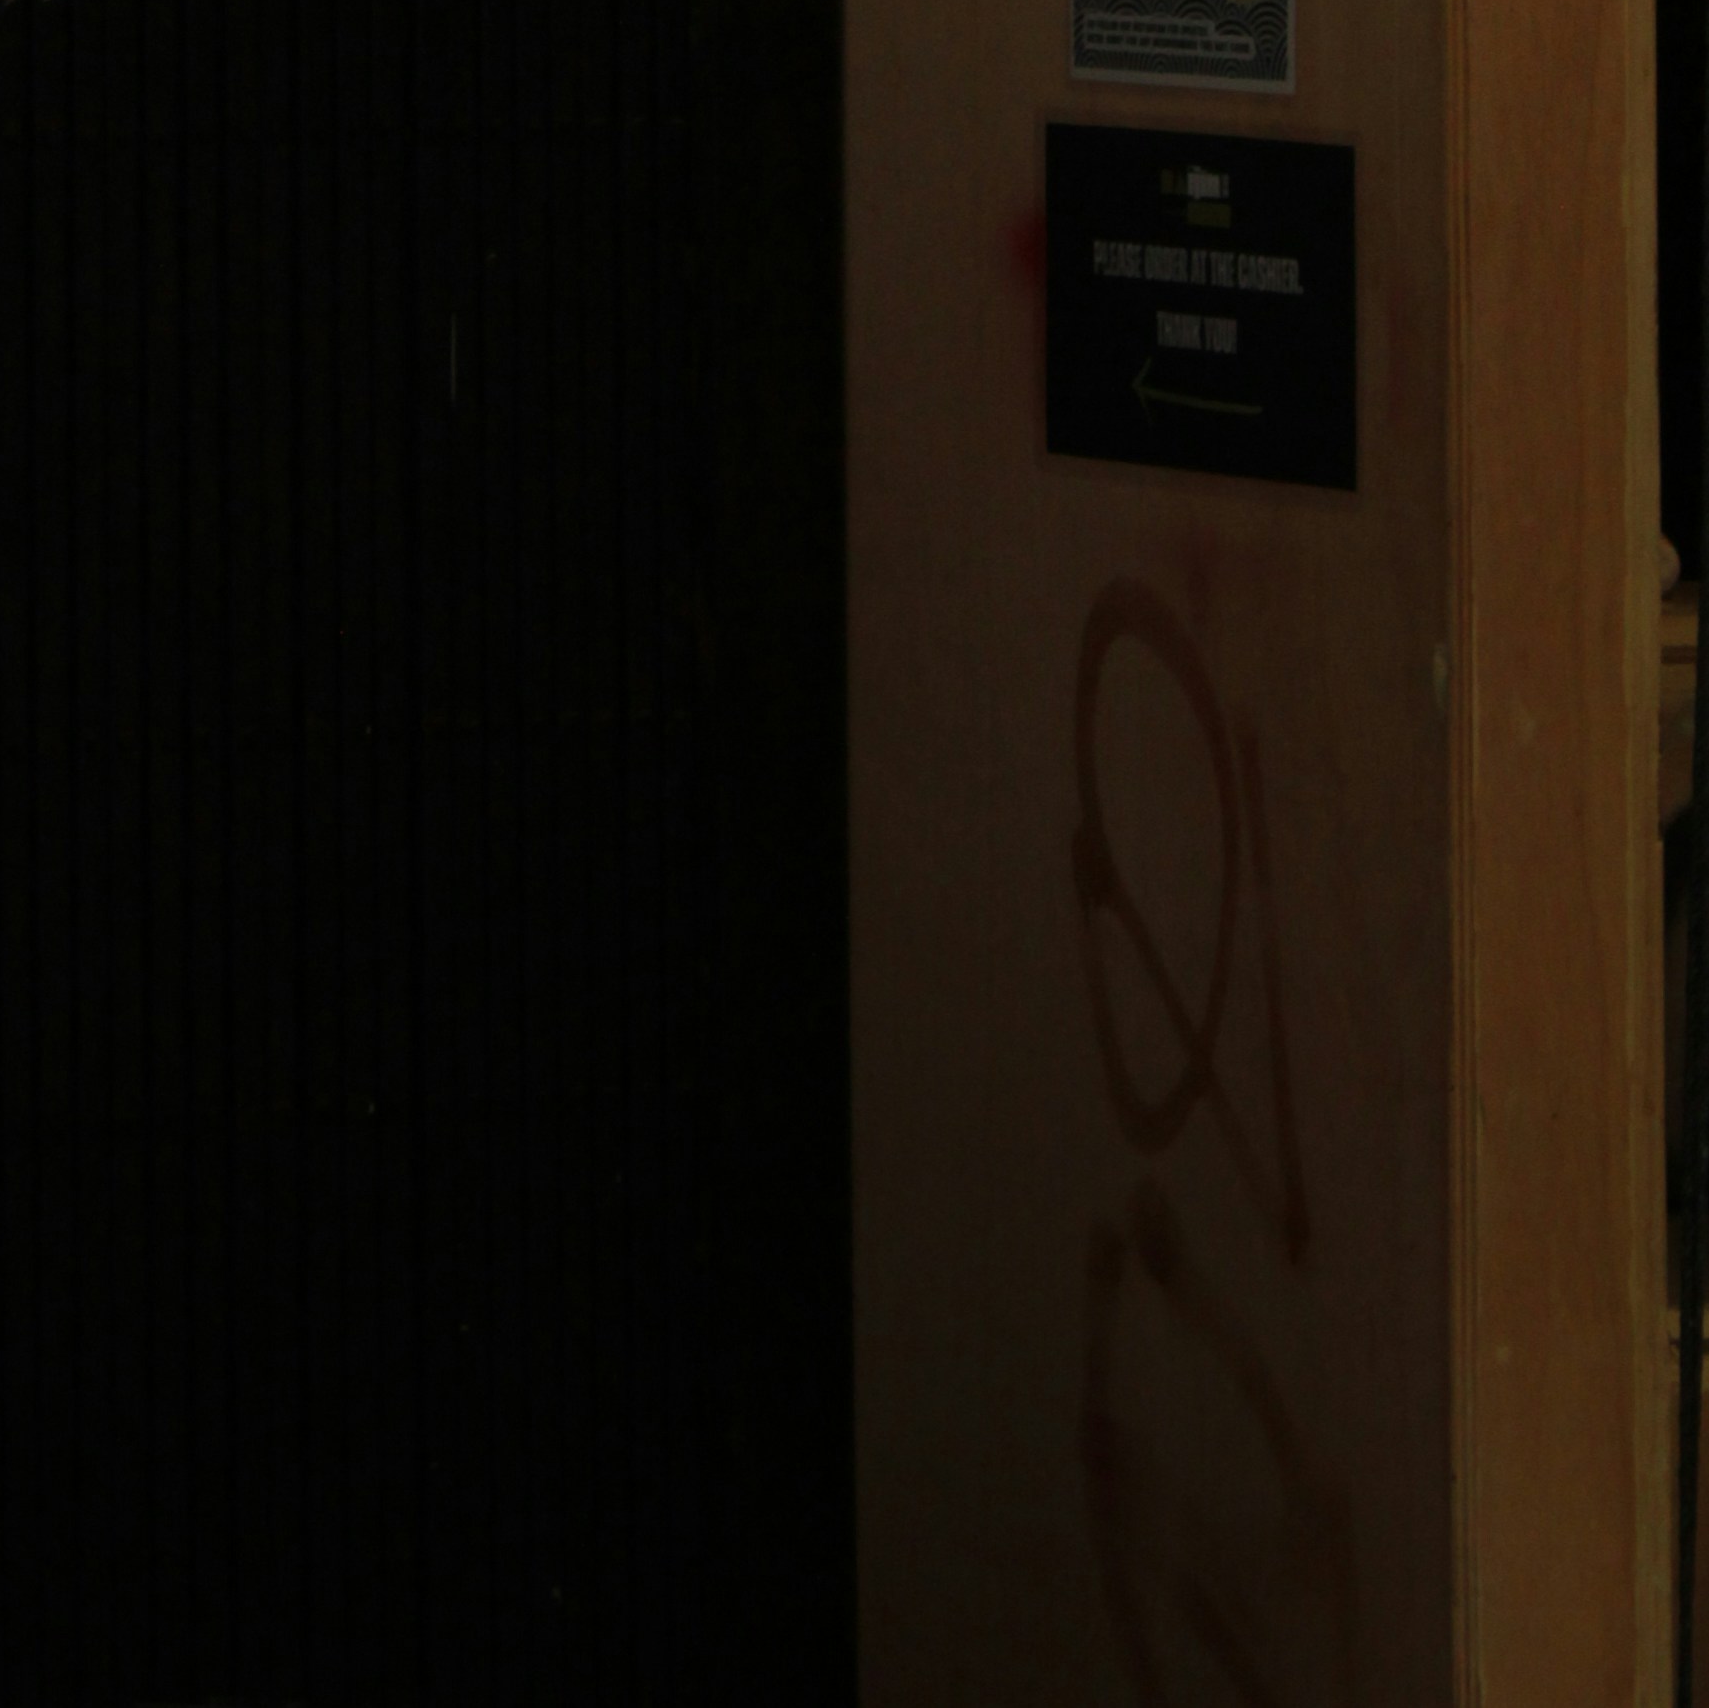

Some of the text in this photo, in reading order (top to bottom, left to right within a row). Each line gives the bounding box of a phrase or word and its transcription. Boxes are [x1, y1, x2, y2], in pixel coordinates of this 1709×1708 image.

[1093, 239, 1143, 279] PLEASE
[1144, 243, 1189, 282] ORDER
[1190, 249, 1209, 285] AT
[1209, 251, 1236, 288] THE
[1156, 310, 1202, 350] THANK
